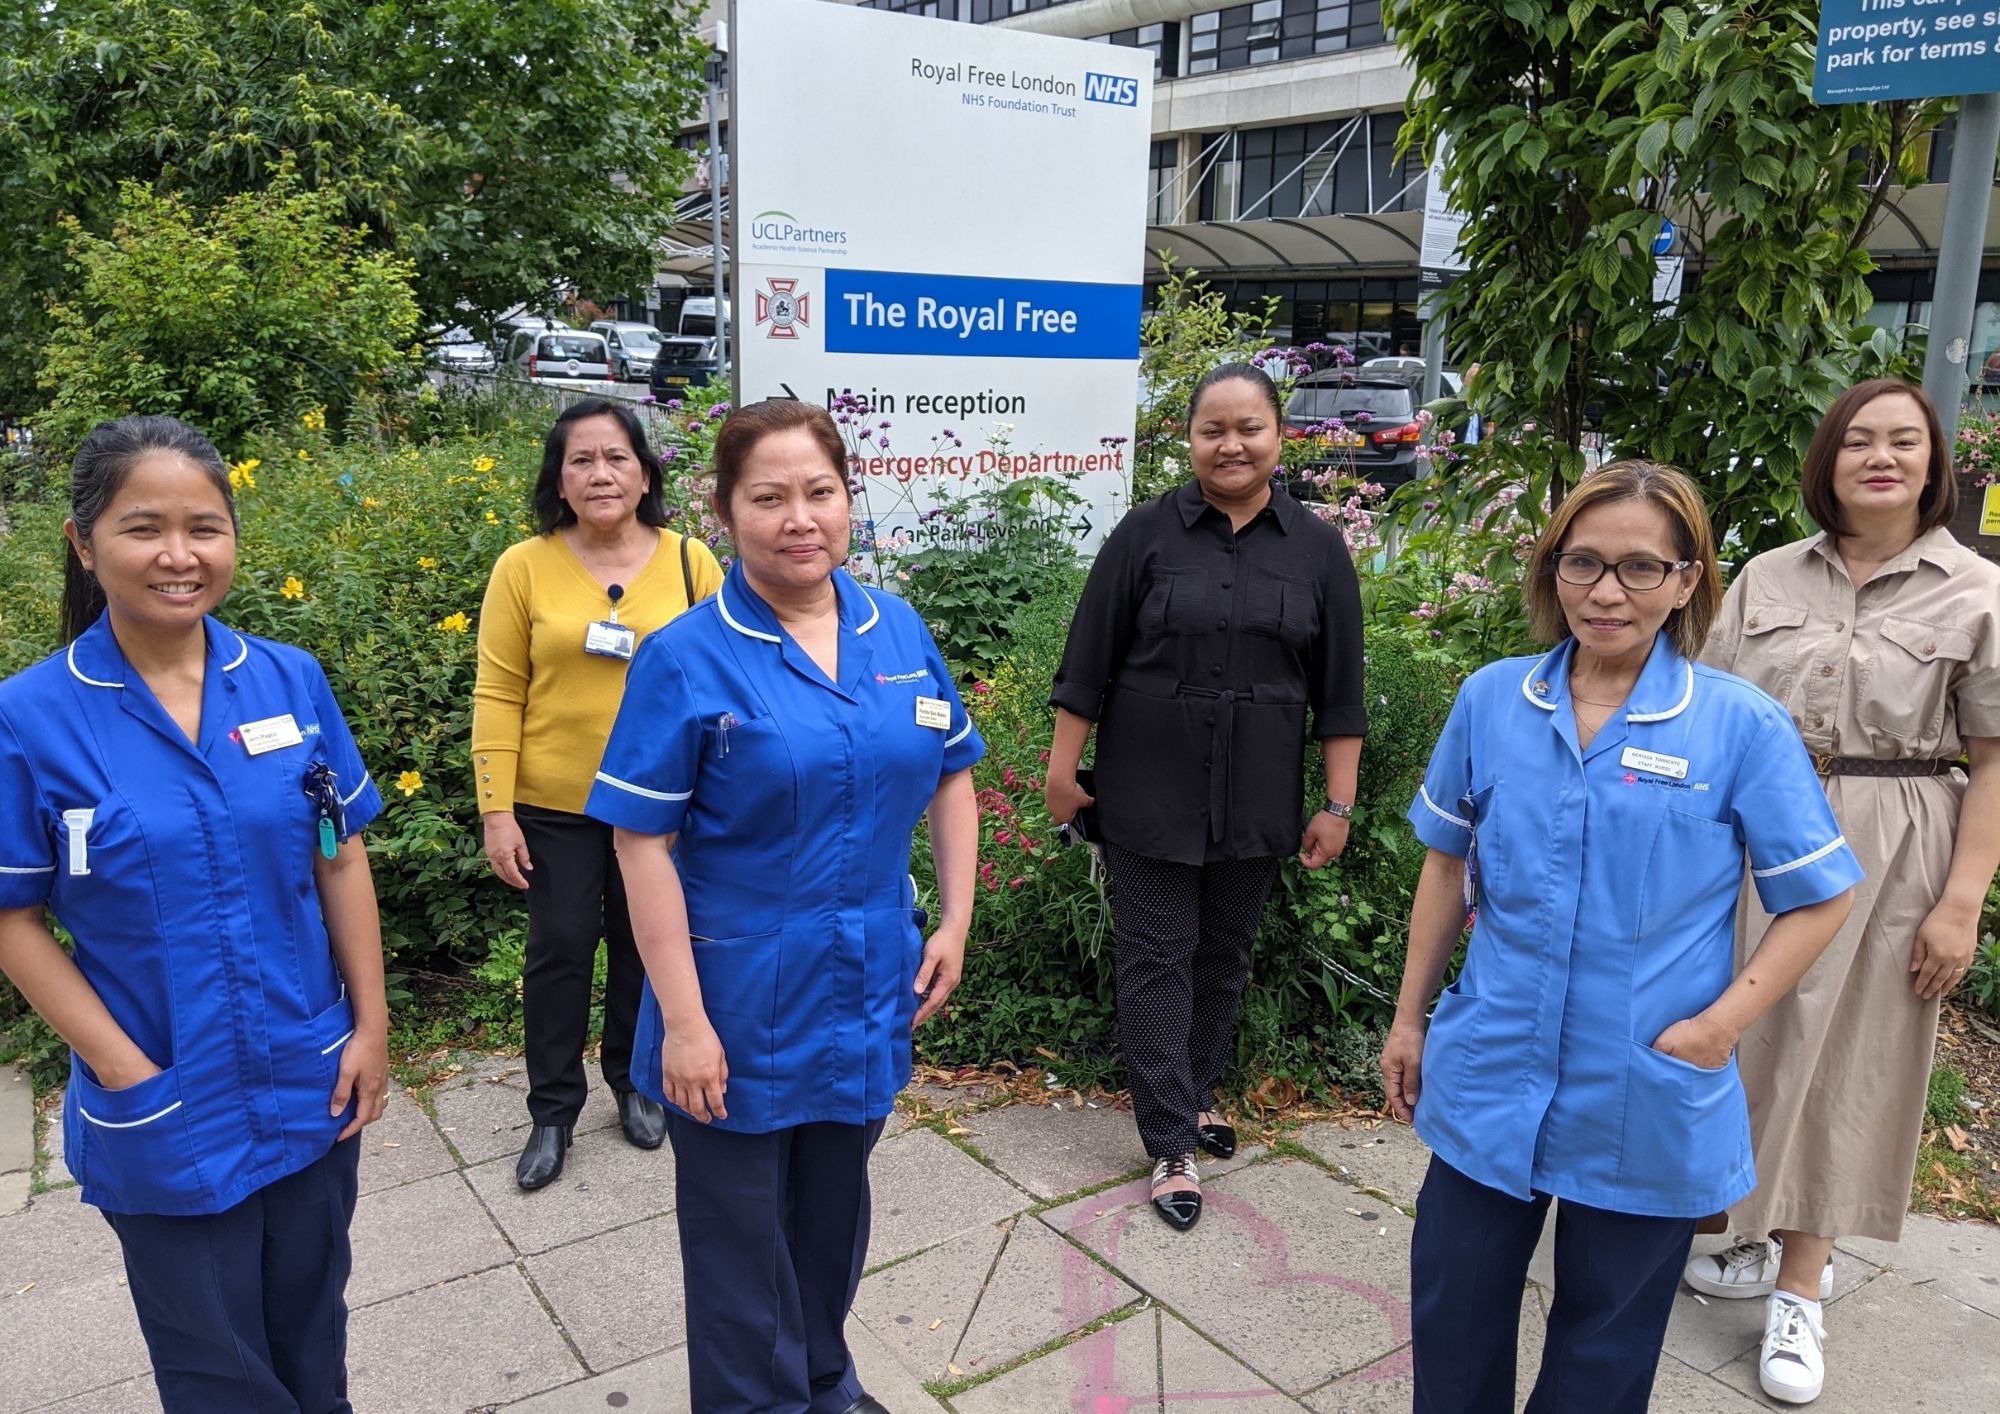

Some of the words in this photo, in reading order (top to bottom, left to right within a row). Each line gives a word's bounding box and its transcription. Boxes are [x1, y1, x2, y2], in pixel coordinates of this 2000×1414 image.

[1828, 16, 1926, 46] property,
[1934, 13, 1976, 31] see
[1826, 47, 1875, 72] park
[1881, 45, 1914, 64] for
[1920, 40, 1986, 61] terms
[911, 58, 961, 85] Royal
[968, 65, 1006, 88] Free
[1012, 70, 1076, 97] London
[1085, 74, 1138, 106] NHS
[962, 93, 985, 107] NHS
[988, 96, 1049, 114] Foundation
[1052, 103, 1077, 118] Trust
[752, 222, 847, 244] UCLPartners
[843, 292, 906, 328] The
[917, 297, 1004, 339] Royal
[1015, 301, 1078, 334] Free
[827, 387, 895, 414] Main
[906, 388, 1026, 421] reception
[845, 453, 974, 482] mergency
[978, 449, 1124, 480] Department
[1637, 776, 1653, 784] Royal
[1655, 778, 1668, 786] Free
[1669, 780, 1691, 790] London
